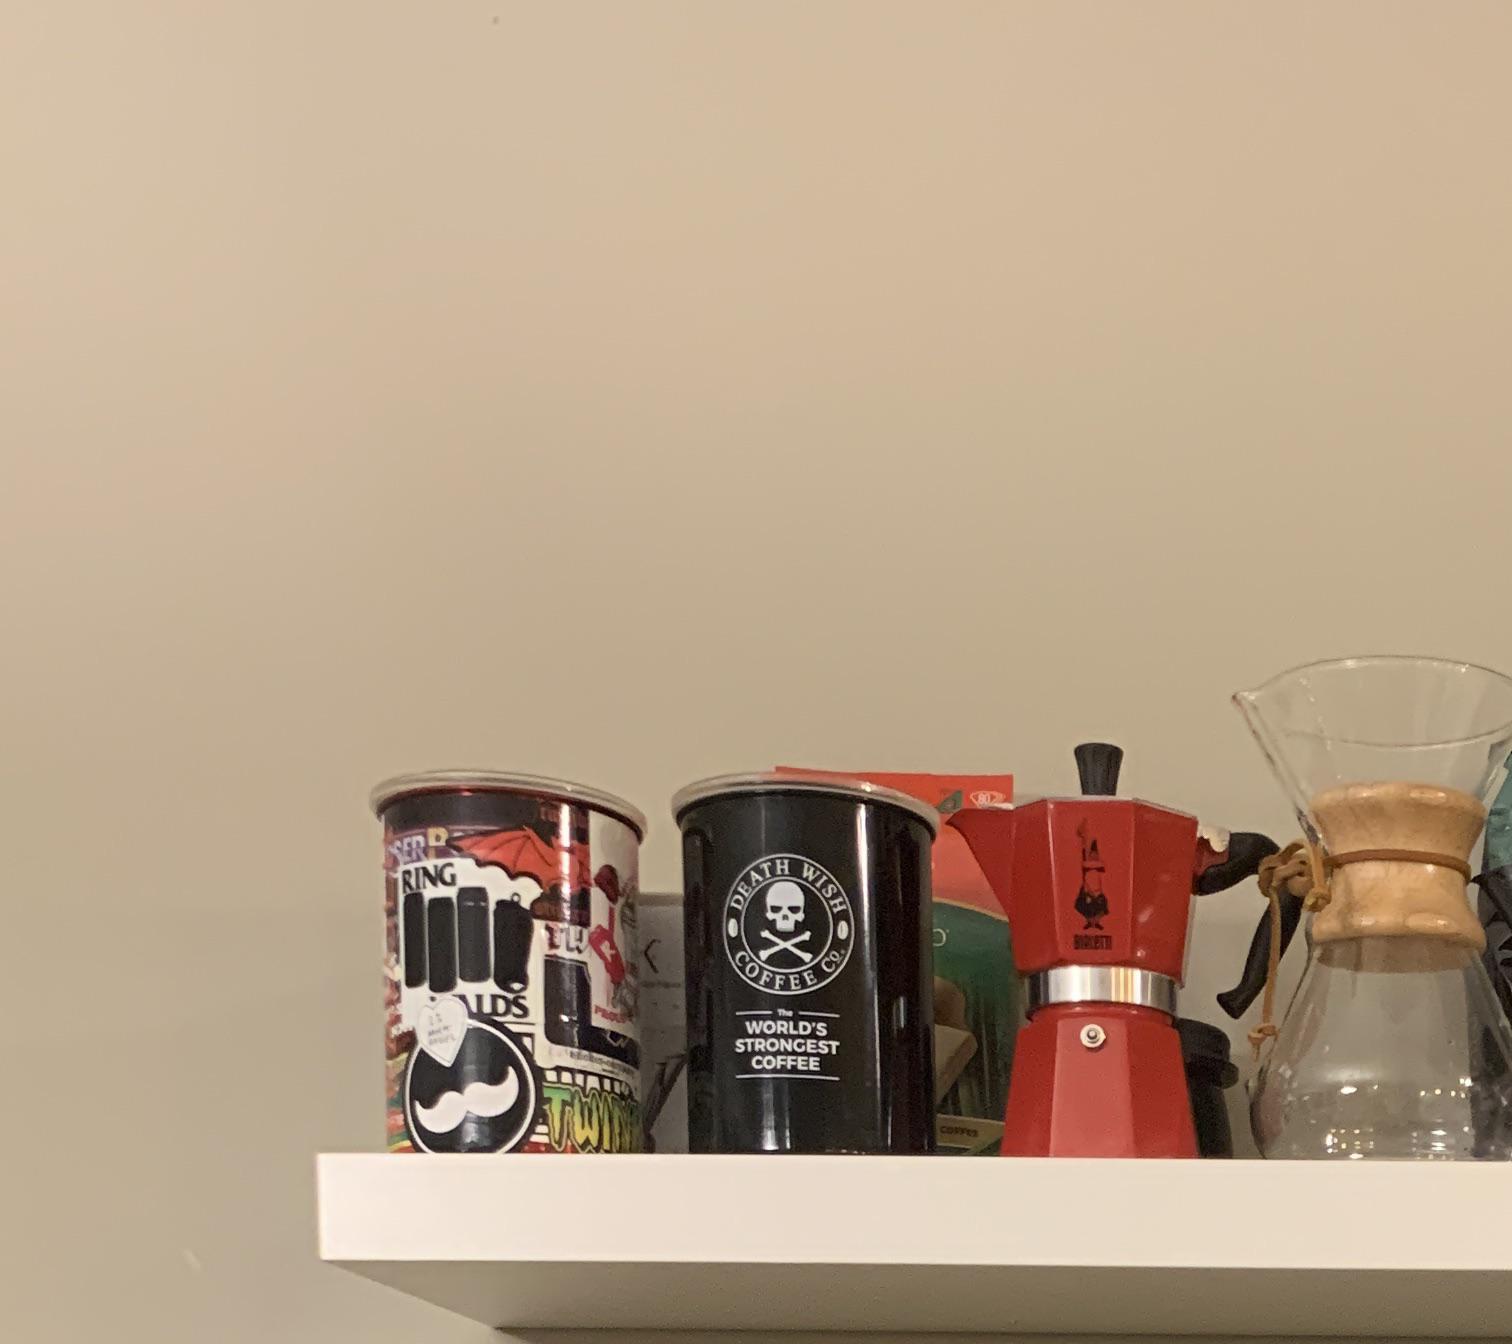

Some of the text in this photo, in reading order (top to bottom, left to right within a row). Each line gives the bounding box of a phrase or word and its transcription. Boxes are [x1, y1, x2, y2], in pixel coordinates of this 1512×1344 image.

[402, 862, 457, 894] RING
[730, 859, 847, 914] DEATH WISH
[735, 951, 818, 991] COFFEE
[777, 1008, 794, 1017] The
[745, 1020, 828, 1037] WORLD'S
[735, 1038, 840, 1055] STRONGEST
[751, 1055, 821, 1071] COFFEE
